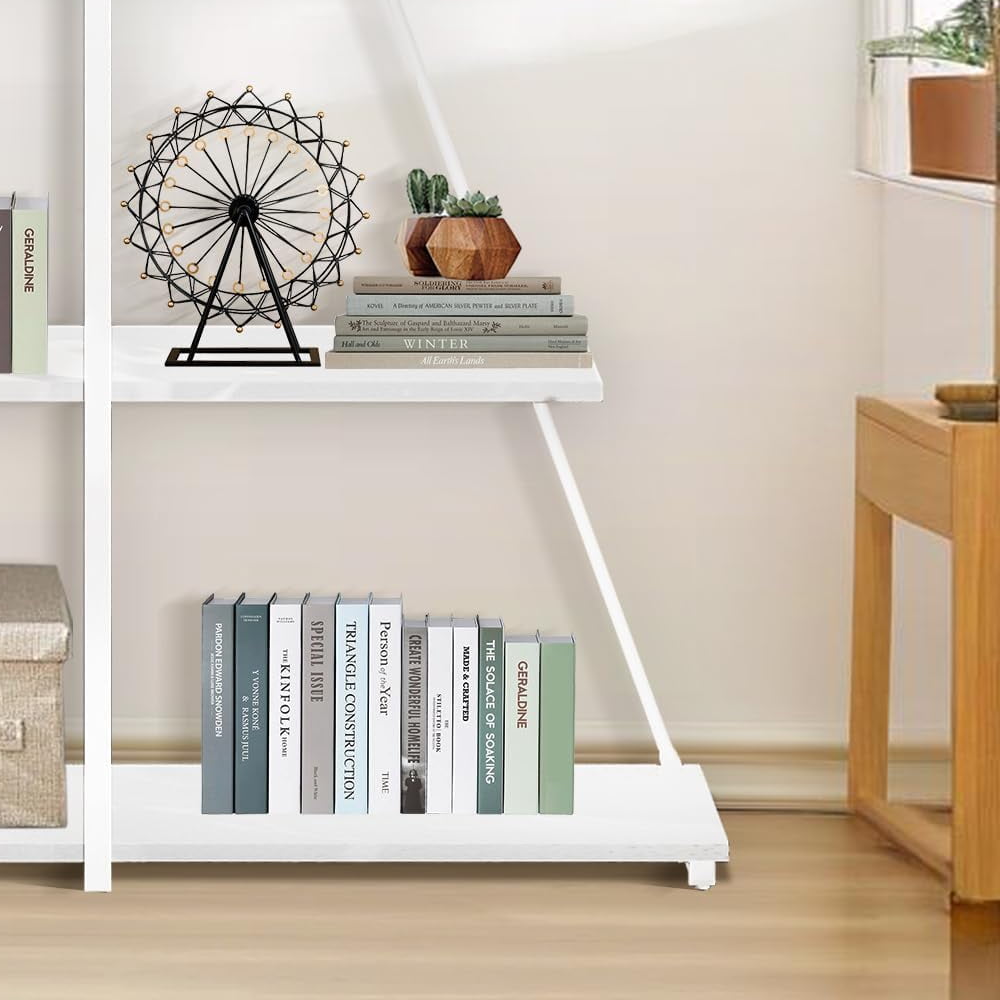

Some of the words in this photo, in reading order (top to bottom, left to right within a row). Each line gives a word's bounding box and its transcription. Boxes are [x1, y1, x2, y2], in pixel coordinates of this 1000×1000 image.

[24, 228, 35, 293] GERALDINE
[404, 339, 470, 349] WINTER
[460, 356, 486, 365] Lands
[215, 623, 223, 657] PARDON
[310, 621, 324, 668] SPECIAL
[344, 621, 357, 690] TRIANGLE
[379, 621, 391, 666] Person
[408, 634, 422, 664] CREATE
[485, 640, 495, 661] THE
[215, 658, 223, 693] EDWARD
[310, 672, 324, 702] ISSUE
[380, 667, 387, 676] of
[485, 665, 495, 711] SOLACE
[279, 664, 291, 737] KINFOLK
[379, 687, 391, 716] Year
[408, 667, 422, 720] WONDERFUL
[517, 661, 528, 729] GERALDINE
[215, 694, 223, 737] SNOWDEN
[485, 713, 495, 728] OF
[343, 694, 357, 800] CONSTRUCTION
[407, 722, 422, 764] HOMELIFE
[485, 732, 495, 784] SOAKING
[381, 772, 389, 794] TIME
